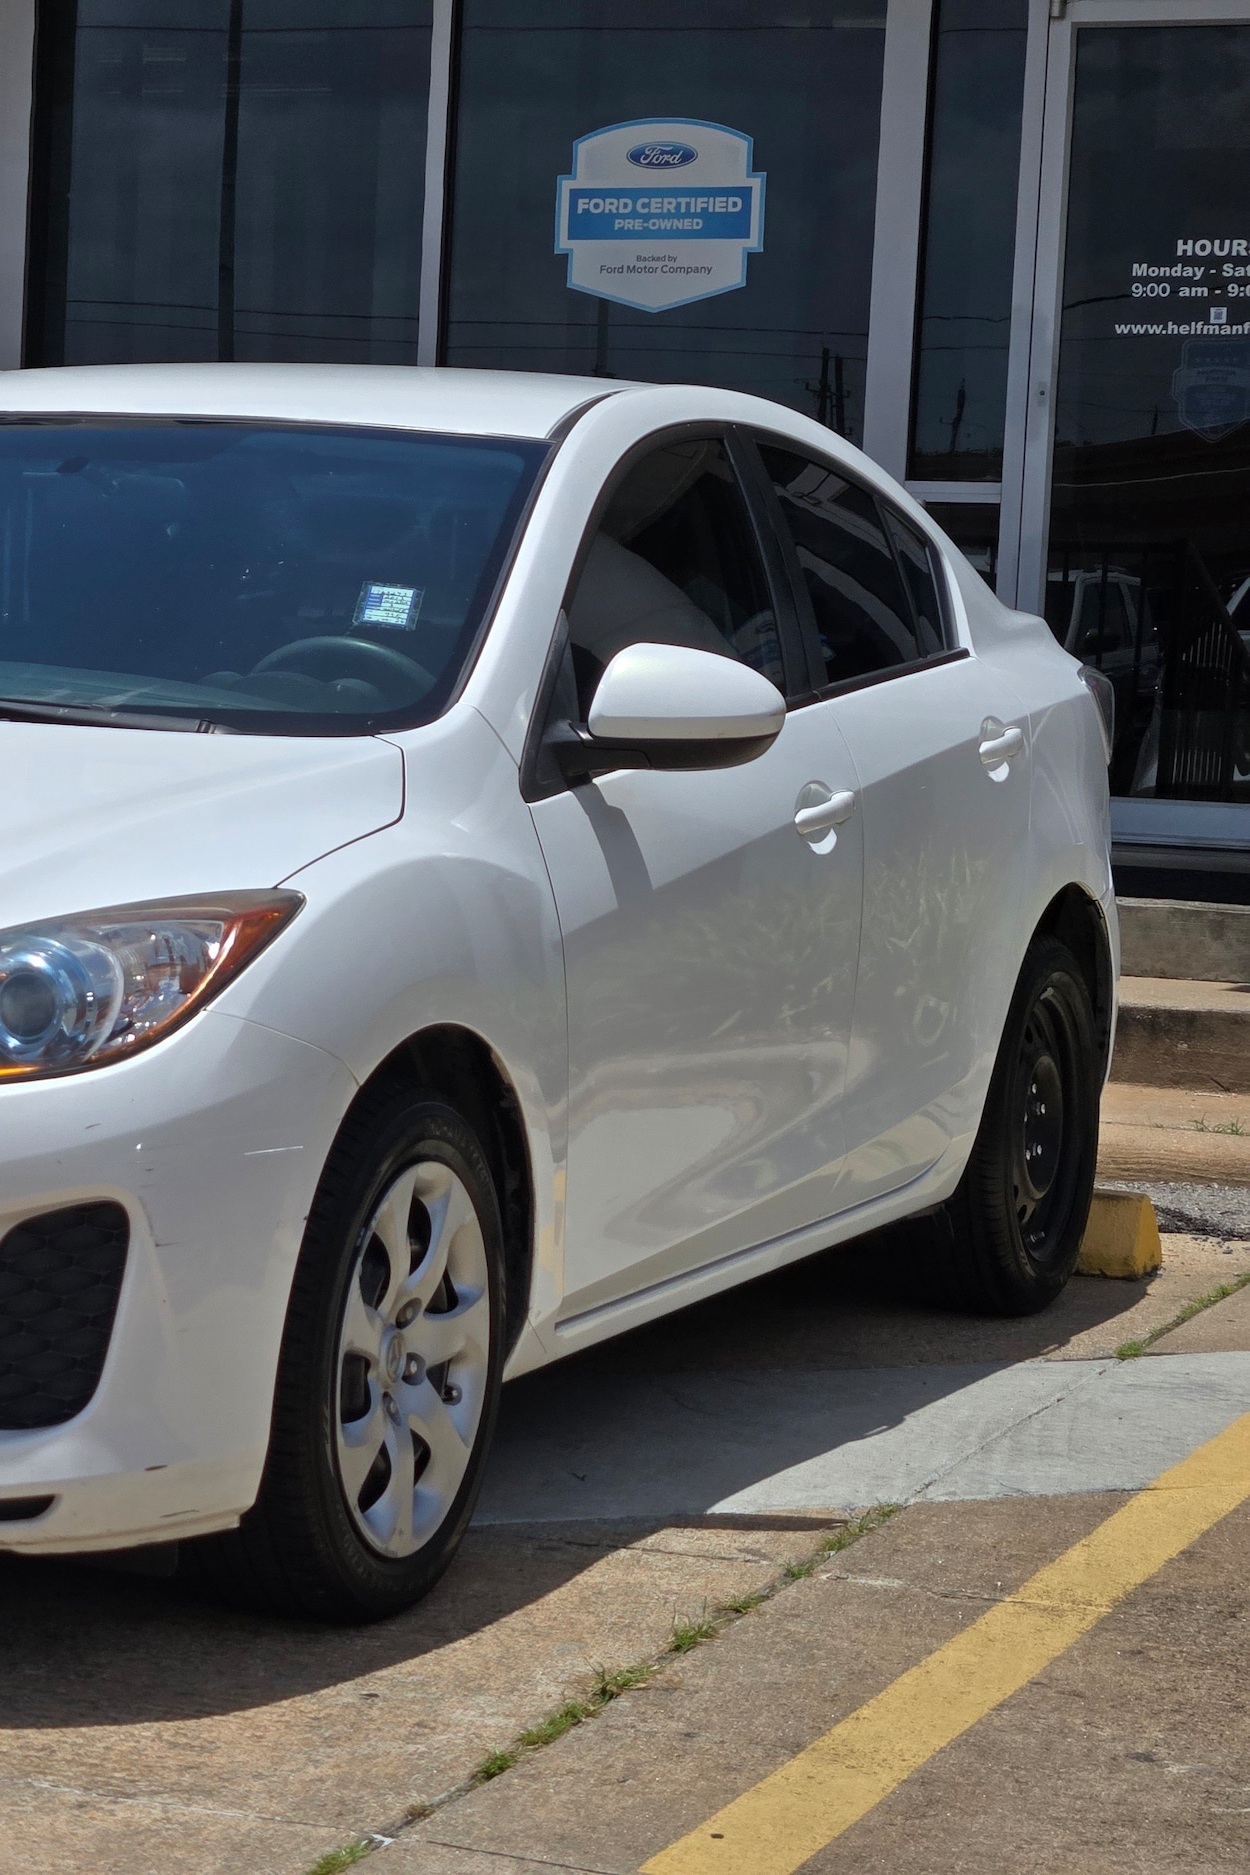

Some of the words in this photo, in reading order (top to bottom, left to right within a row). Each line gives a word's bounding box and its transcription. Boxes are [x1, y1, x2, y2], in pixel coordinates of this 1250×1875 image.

[640, 144, 683, 165] Ford
[577, 198, 633, 214] FORD
[636, 196, 743, 214] CERTIFIED
[614, 218, 703, 230] PRE-OWNED
[1176, 238, 1250, 257] HOUR
[636, 254, 667, 263] Backed
[667, 254, 678, 264] by
[600, 264, 624, 275] Ford
[626, 264, 660, 275] Motor
[660, 264, 713, 276] Company
[1131, 263, 1205, 281] Monday
[1131, 282, 1171, 298] 9:00
[1178, 286, 1209, 298] am
